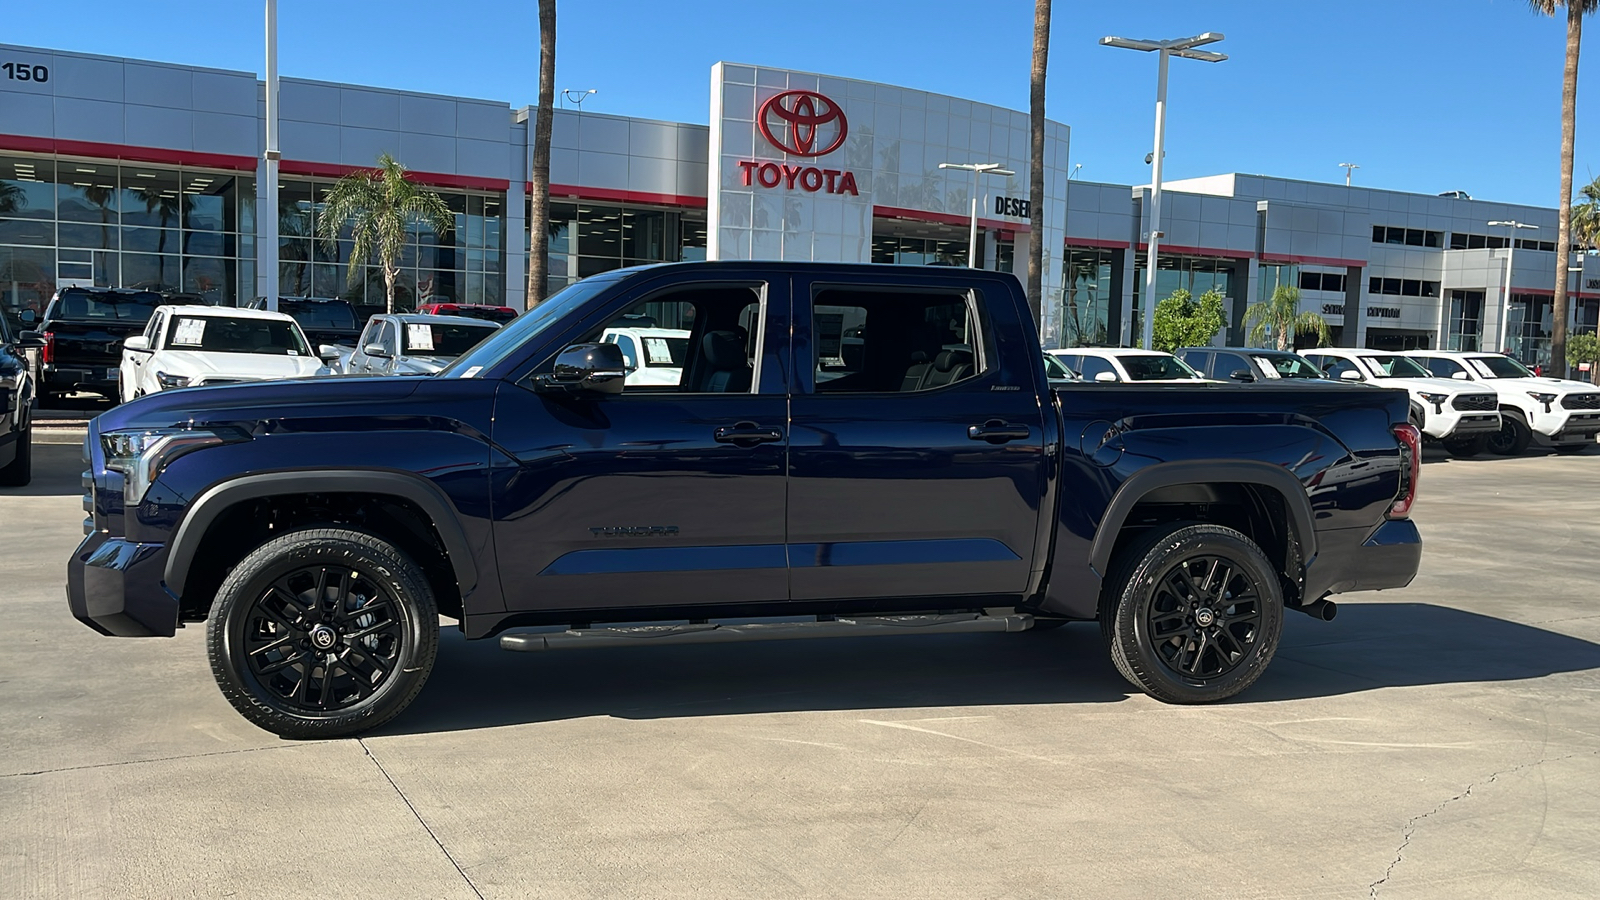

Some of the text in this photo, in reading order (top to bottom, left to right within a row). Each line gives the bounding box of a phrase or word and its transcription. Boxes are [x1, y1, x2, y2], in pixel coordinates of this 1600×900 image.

[0, 62, 49, 83] 150
[737, 160, 859, 196] TOYOTA
[995, 195, 1031, 219] DESER
[587, 525, 680, 539] TUNDRA
